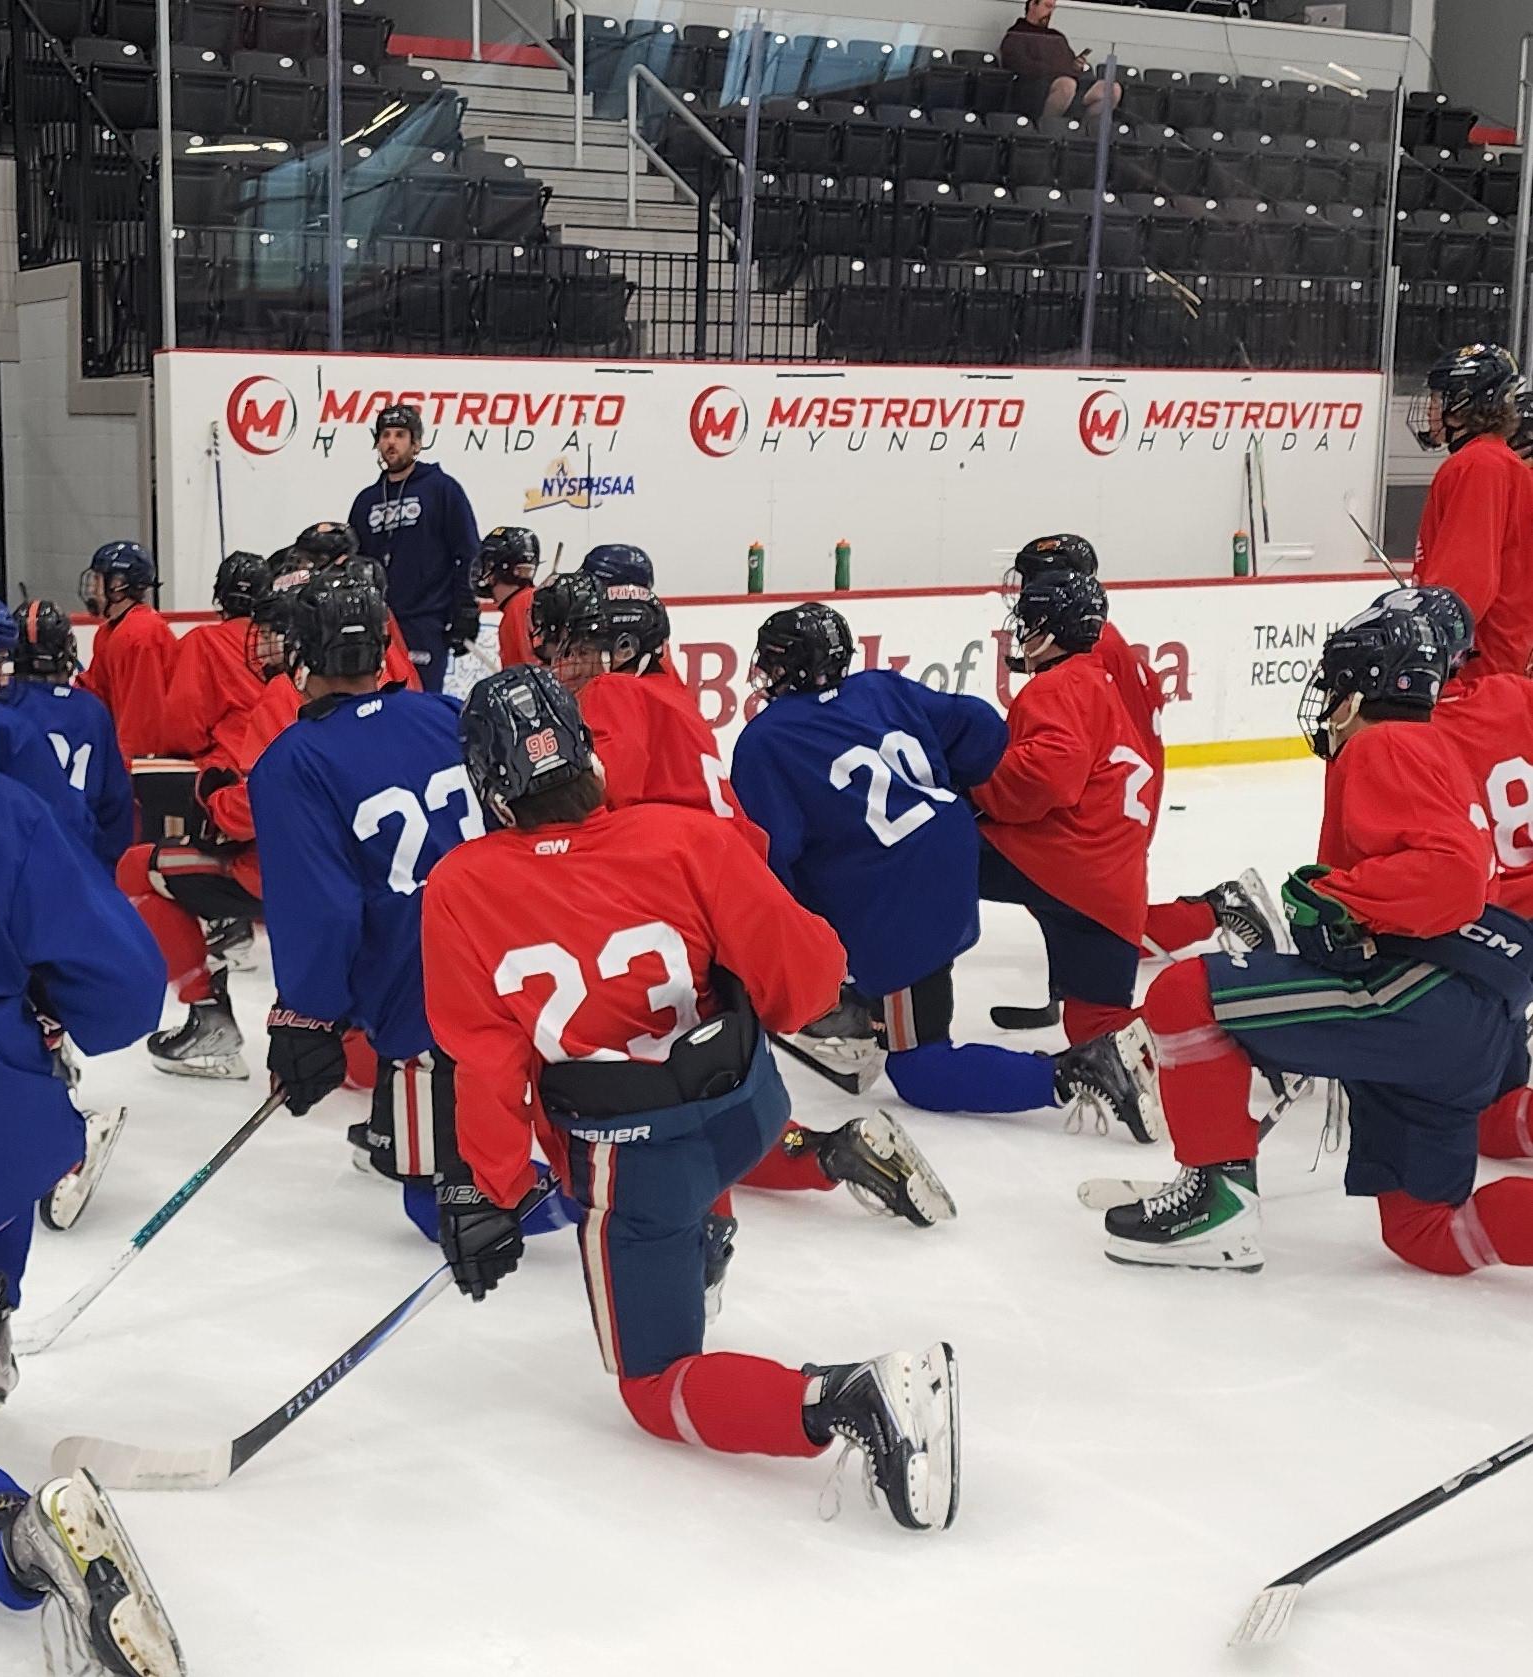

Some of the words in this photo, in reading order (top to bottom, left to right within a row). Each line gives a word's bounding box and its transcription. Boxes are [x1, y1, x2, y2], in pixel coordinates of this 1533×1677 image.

[766, 396, 1027, 429] MASTROVITO
[1143, 400, 1364, 430] MASTROVITO
[312, 426, 618, 453] HUNDAI
[760, 431, 1019, 453] HYUNDAI
[1137, 431, 1357, 452] HYUNDAI
[541, 475, 635, 498] NYSPHSAA
[1253, 622, 1316, 650] TRAIN
[1251, 659, 1313, 686] RECO
[525, 727, 559, 763] 96
[533, 839, 571, 856] GW
[494, 920, 701, 1064] 23
[285, 1352, 353, 1419] FLYLITE
